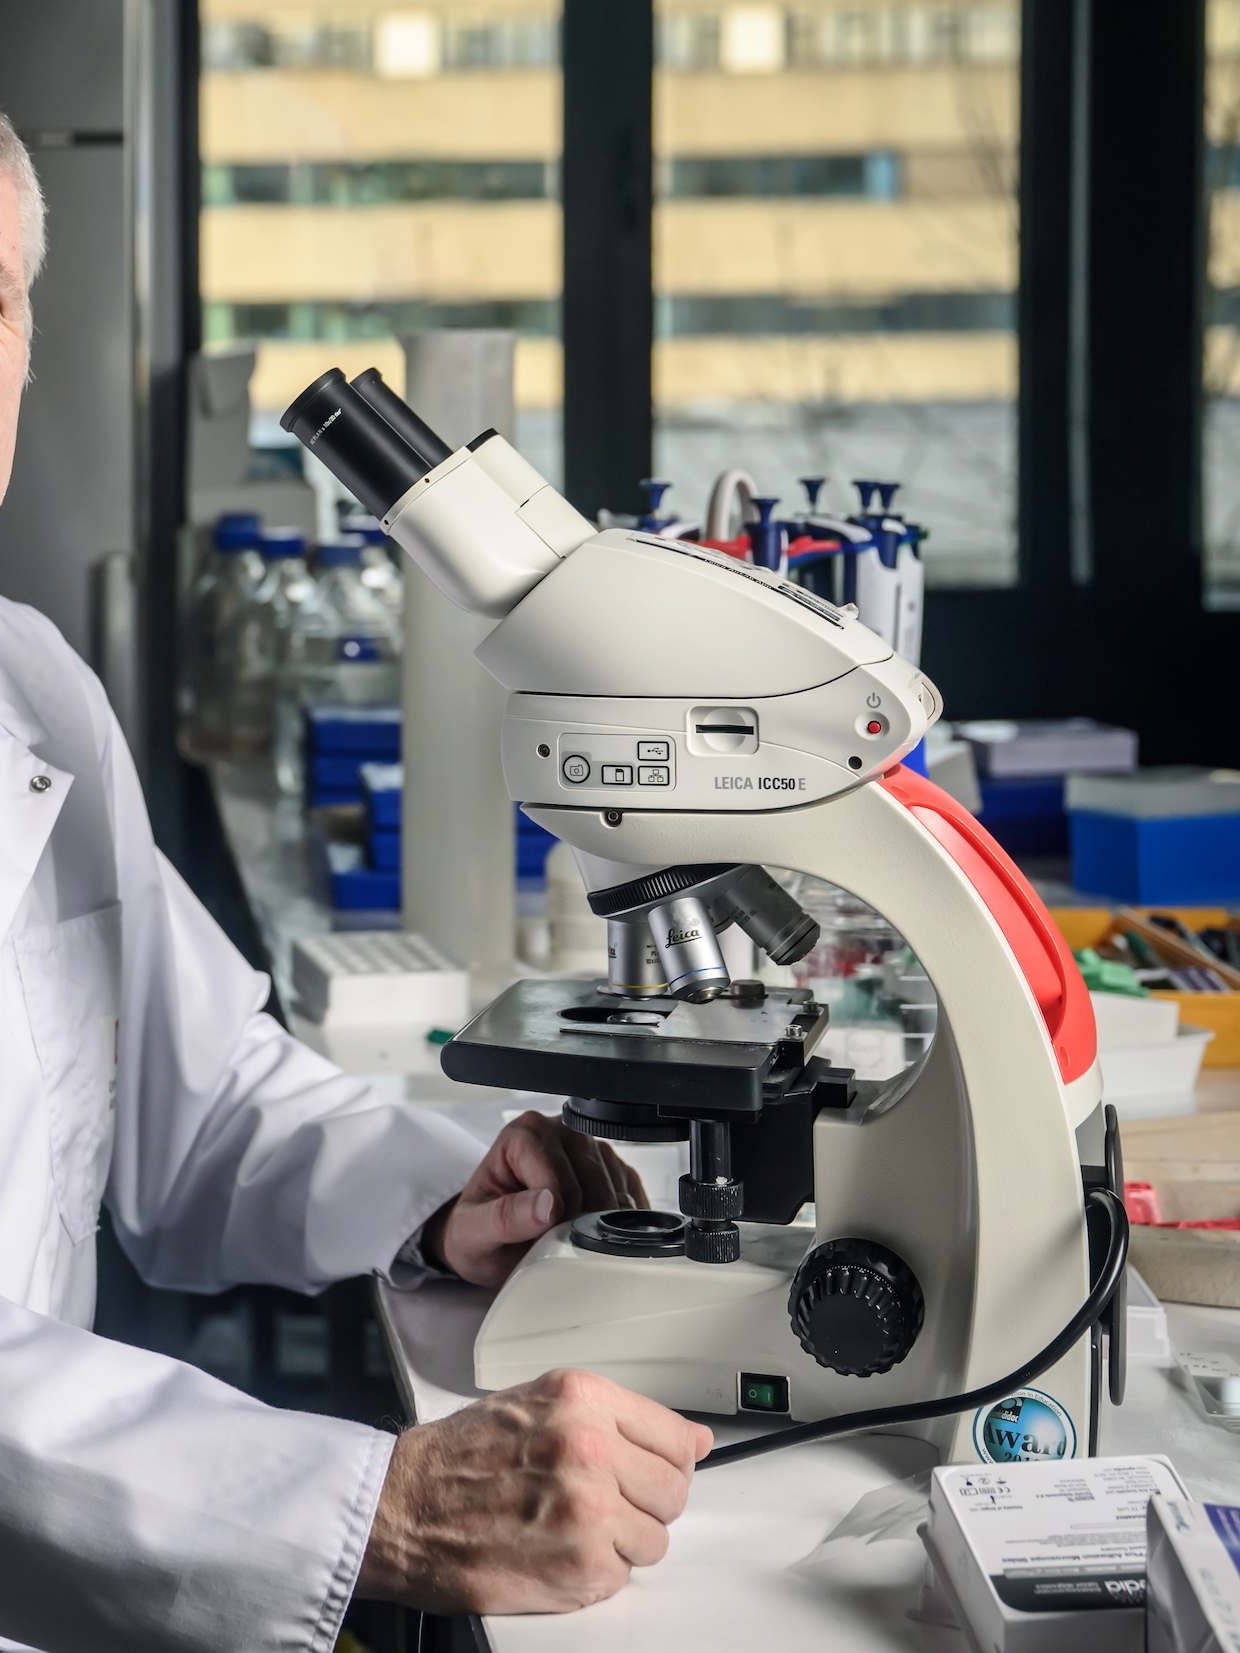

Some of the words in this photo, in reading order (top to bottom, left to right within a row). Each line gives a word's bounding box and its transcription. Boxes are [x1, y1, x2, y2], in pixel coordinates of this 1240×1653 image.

[714, 776, 754, 790] LEICA
[758, 777, 796, 790] ICC50
[798, 777, 807, 791] E
[665, 928, 703, 949] Leica
[1034, 1393, 1063, 1417] Education
[984, 1421, 1067, 1456] Award
